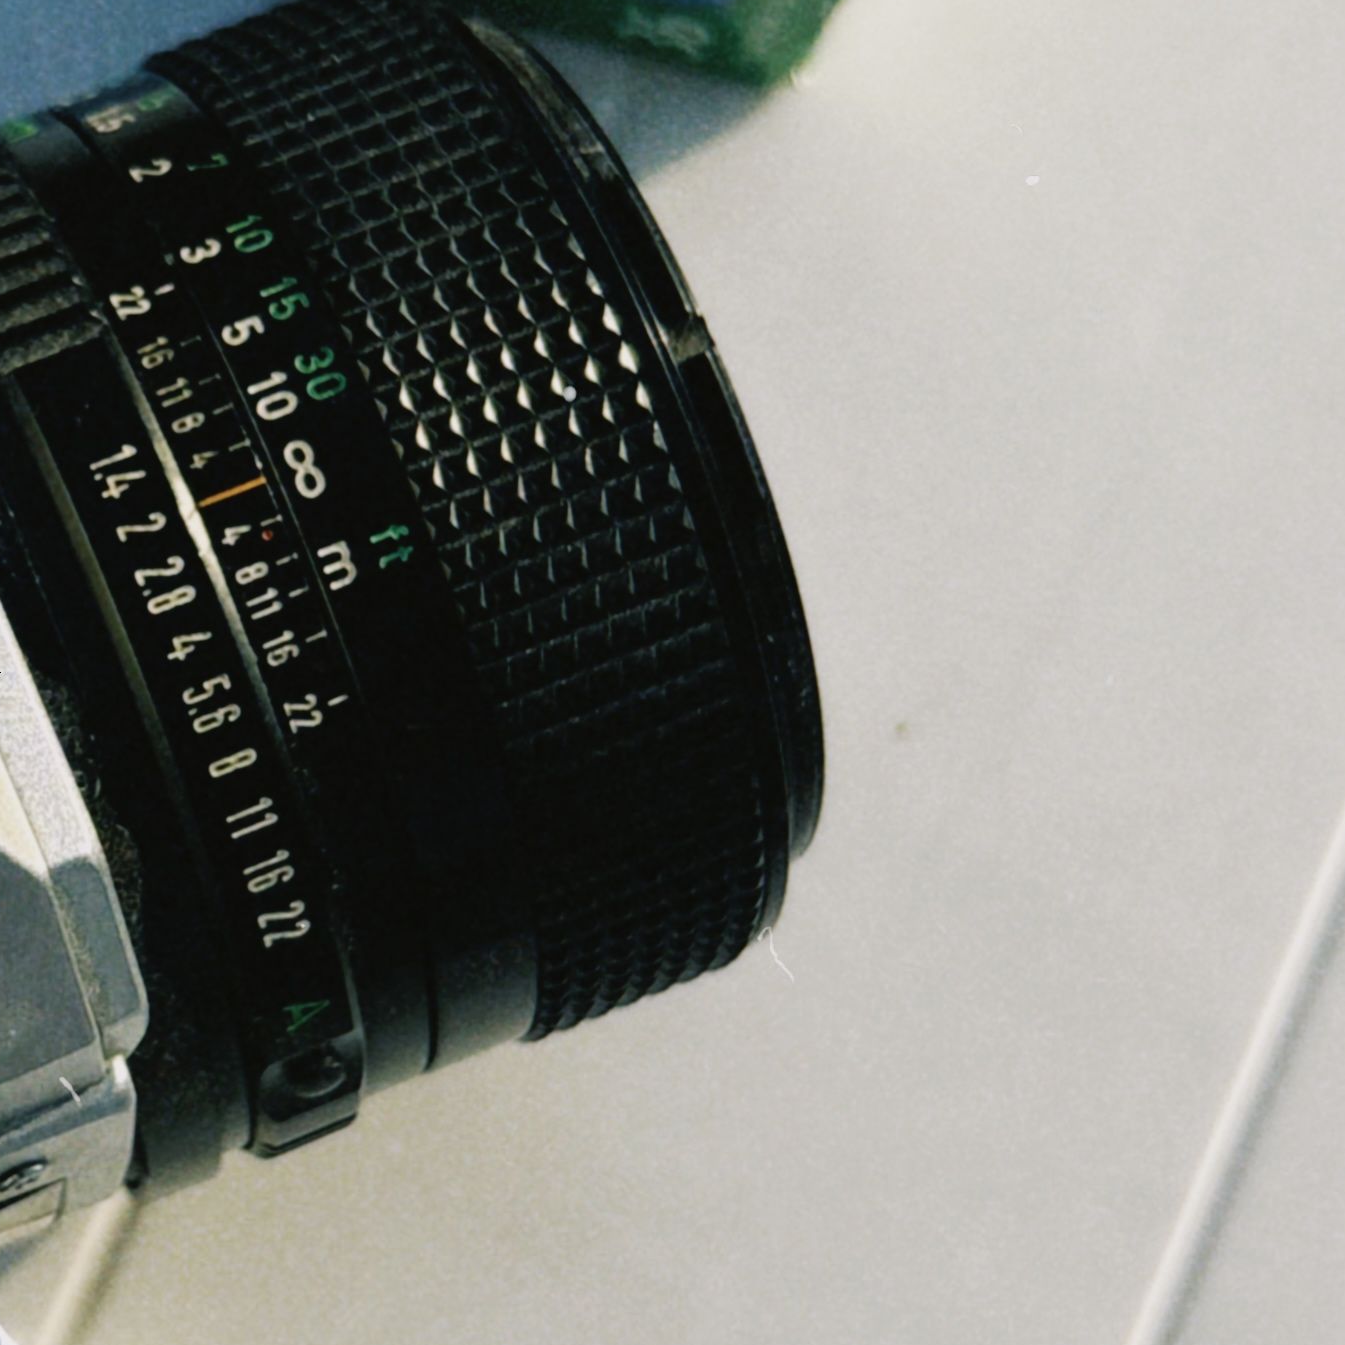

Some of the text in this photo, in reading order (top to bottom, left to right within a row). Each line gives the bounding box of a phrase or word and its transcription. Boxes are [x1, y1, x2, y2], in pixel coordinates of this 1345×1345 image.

[110, 286, 323, 734] 22 16 11 8 4 4 8 11 16 22
[129, 159, 172, 183] 2
[180, 237, 220, 264] 3
[222, 316, 265, 346] 5
[248, 370, 297, 420] 10
[318, 540, 356, 590] m
[226, 214, 273, 253] 10
[260, 276, 308, 321] 15
[295, 347, 346, 400] 30
[370, 523, 413, 568] ft
[89, 444, 330, 1033] 1.4 2 2.8 4 5.6 8 11 16 22 A
